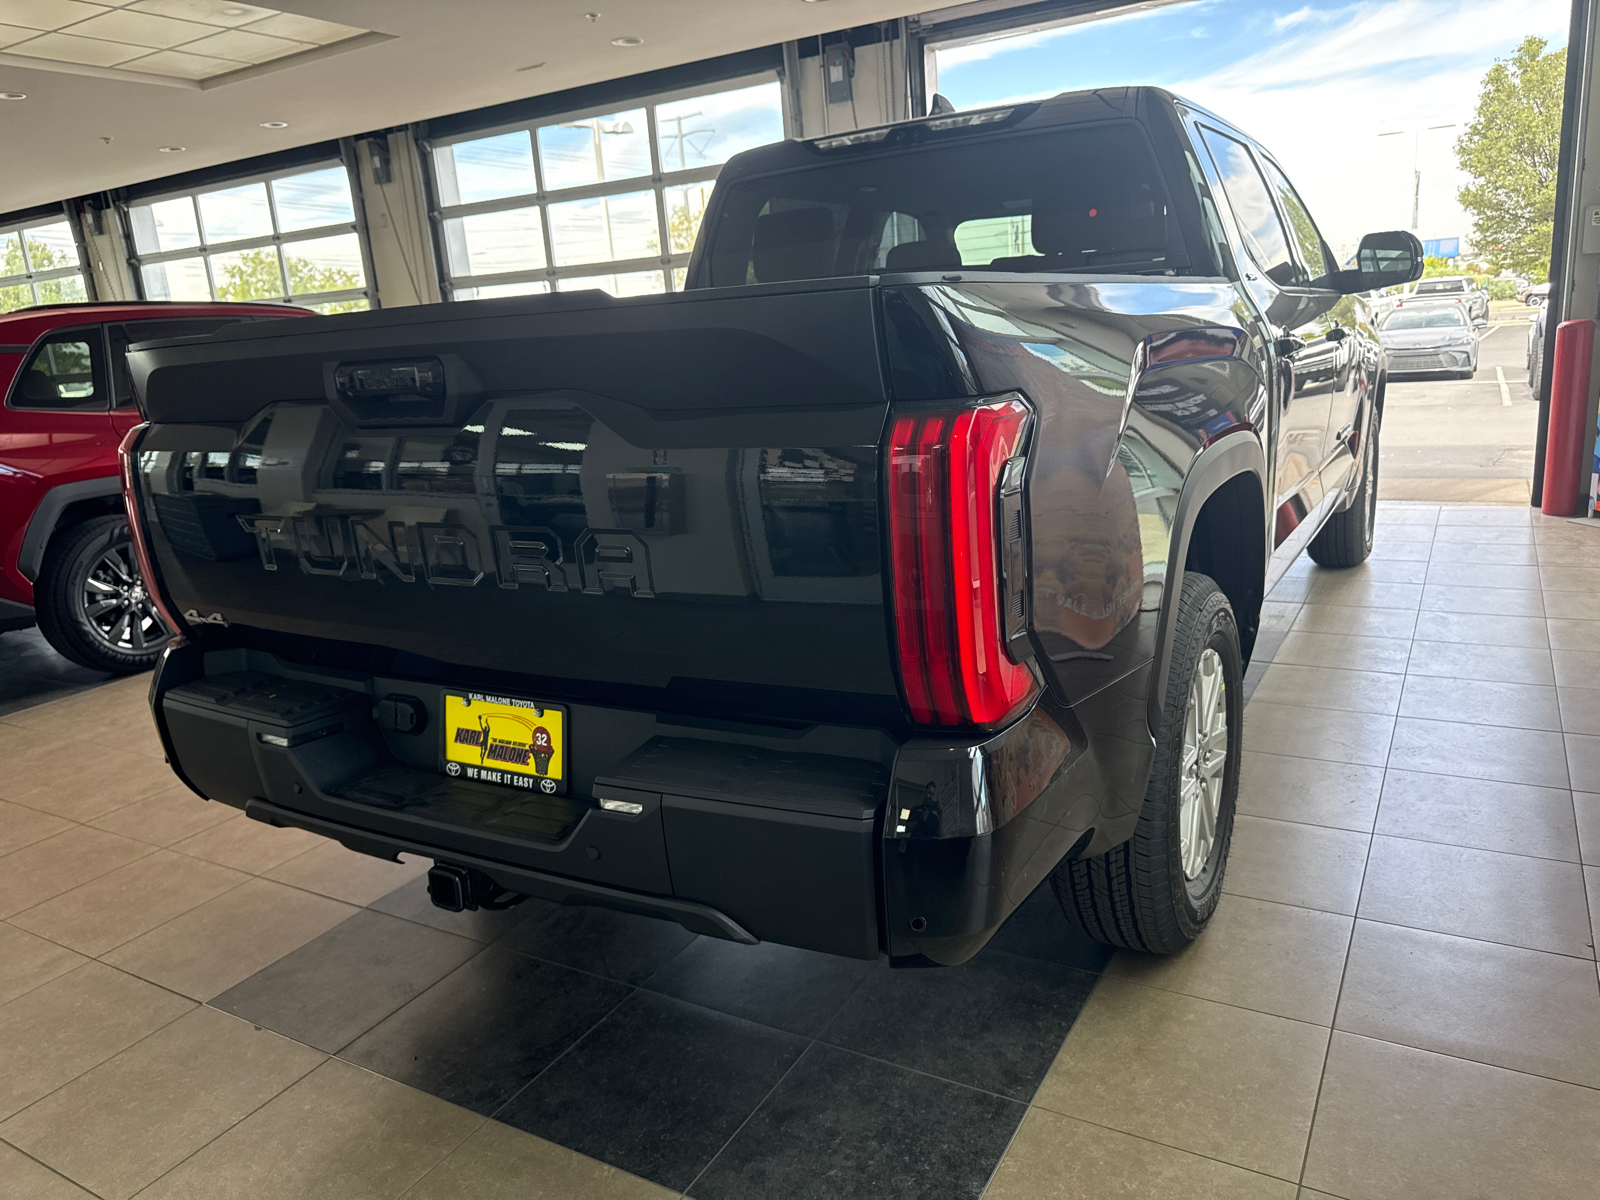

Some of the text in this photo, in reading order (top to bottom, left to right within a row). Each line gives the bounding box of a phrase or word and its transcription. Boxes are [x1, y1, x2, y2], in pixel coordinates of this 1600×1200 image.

[235, 513, 656, 599] TUNDRA
[468, 692, 535, 709] KARL MALONE TOYOTA
[454, 727, 482, 747] KARL
[535, 732, 547, 747] 32
[486, 743, 531, 766] MALONE
[467, 766, 534, 789] WE MAKE IT EASY
